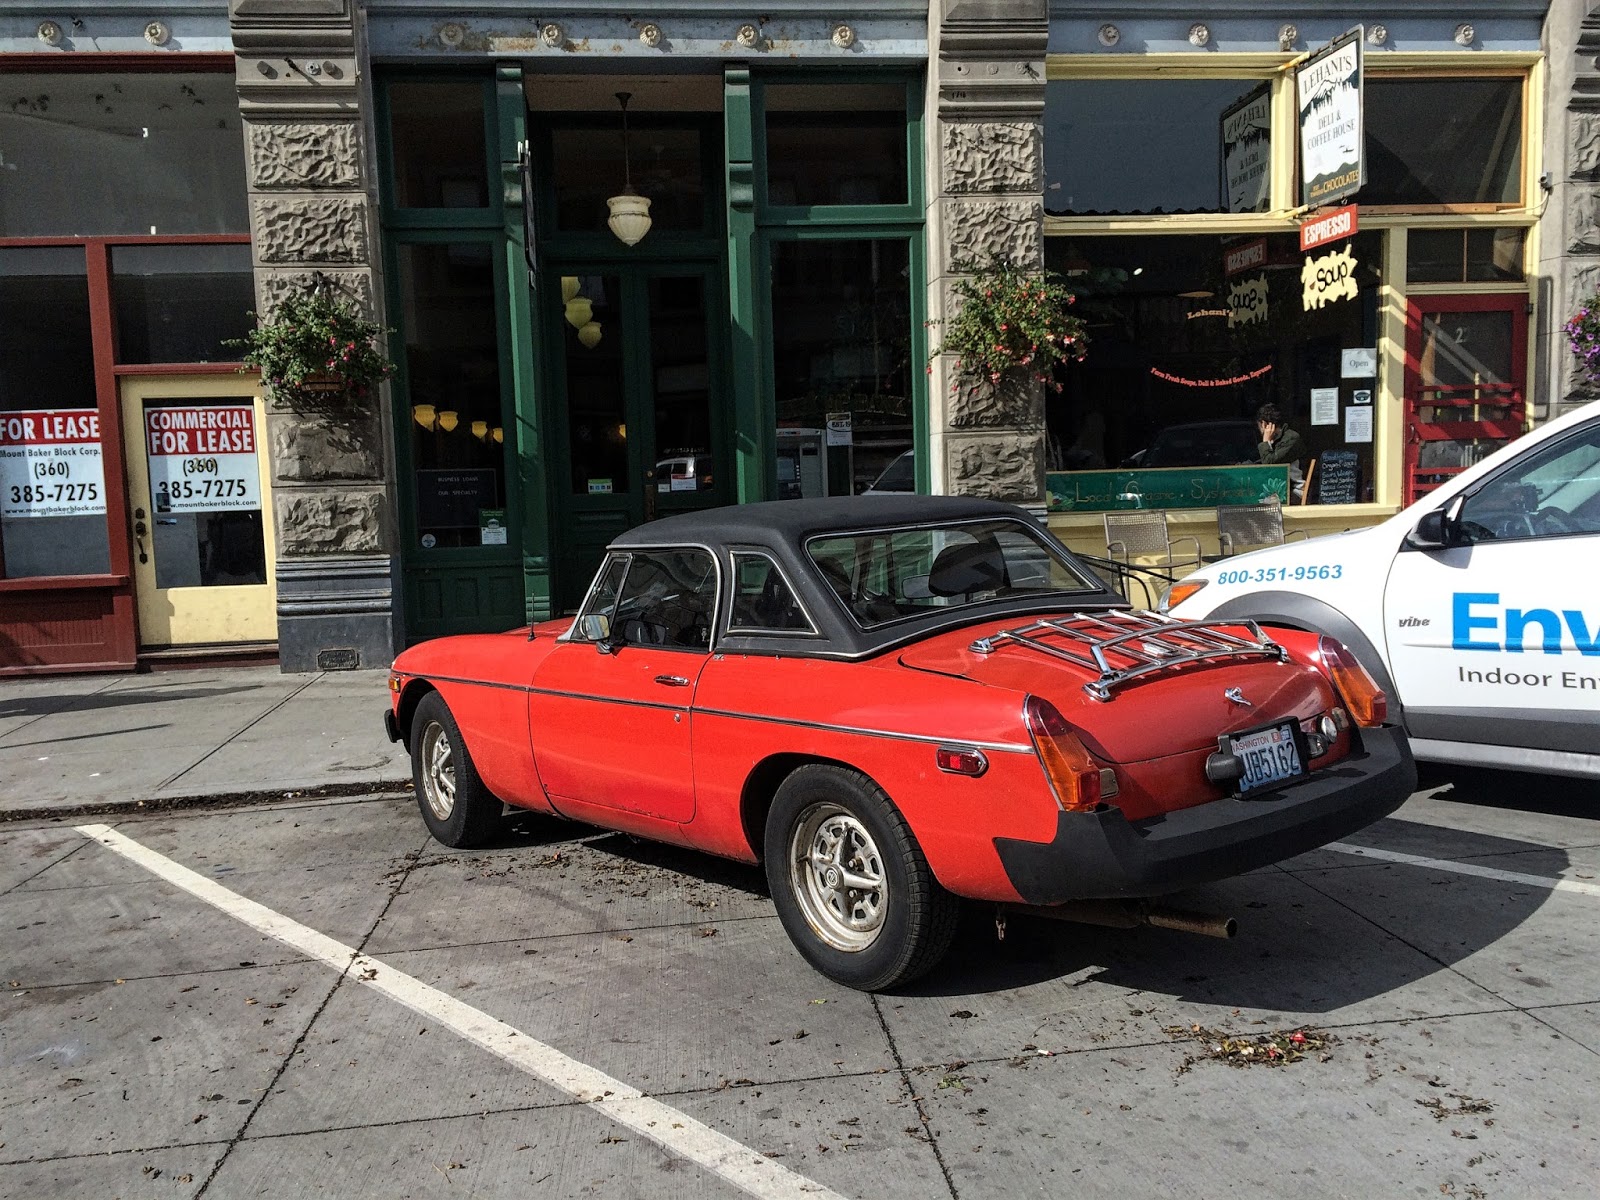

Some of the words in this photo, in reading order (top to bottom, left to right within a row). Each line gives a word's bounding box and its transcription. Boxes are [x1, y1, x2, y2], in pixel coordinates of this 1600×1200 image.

[1303, 55, 1353, 95] LEHANI'S
[1318, 112, 1334, 130] DELI
[1336, 109, 1341, 121] &
[1307, 129, 1332, 150] COFFEE
[1332, 118, 1355, 139] HOUSE
[1323, 169, 1359, 193] CHOCOLATES
[1304, 211, 1351, 246] ESPRESSO
[1316, 261, 1348, 293] Soup
[1349, 359, 1369, 369] Open
[0, 418, 36, 440] FOR
[43, 416, 100, 439] LEASE
[150, 410, 251, 430] COMMERCIAL
[28, 448, 51, 457] Baker
[54, 447, 77, 456] Block
[79, 446, 101, 456] Corp.
[151, 431, 190, 453] FOR
[196, 430, 252, 452] LEASE
[34, 461, 70, 479] (360)
[183, 459, 218, 477] (360)
[11, 482, 97, 503] 385-7275
[159, 479, 246, 498] 385-7275
[1218, 565, 1342, 585] 800-351-9563
[1398, 616, 1430, 628] vibe
[1459, 666, 1552, 687] Indoor
